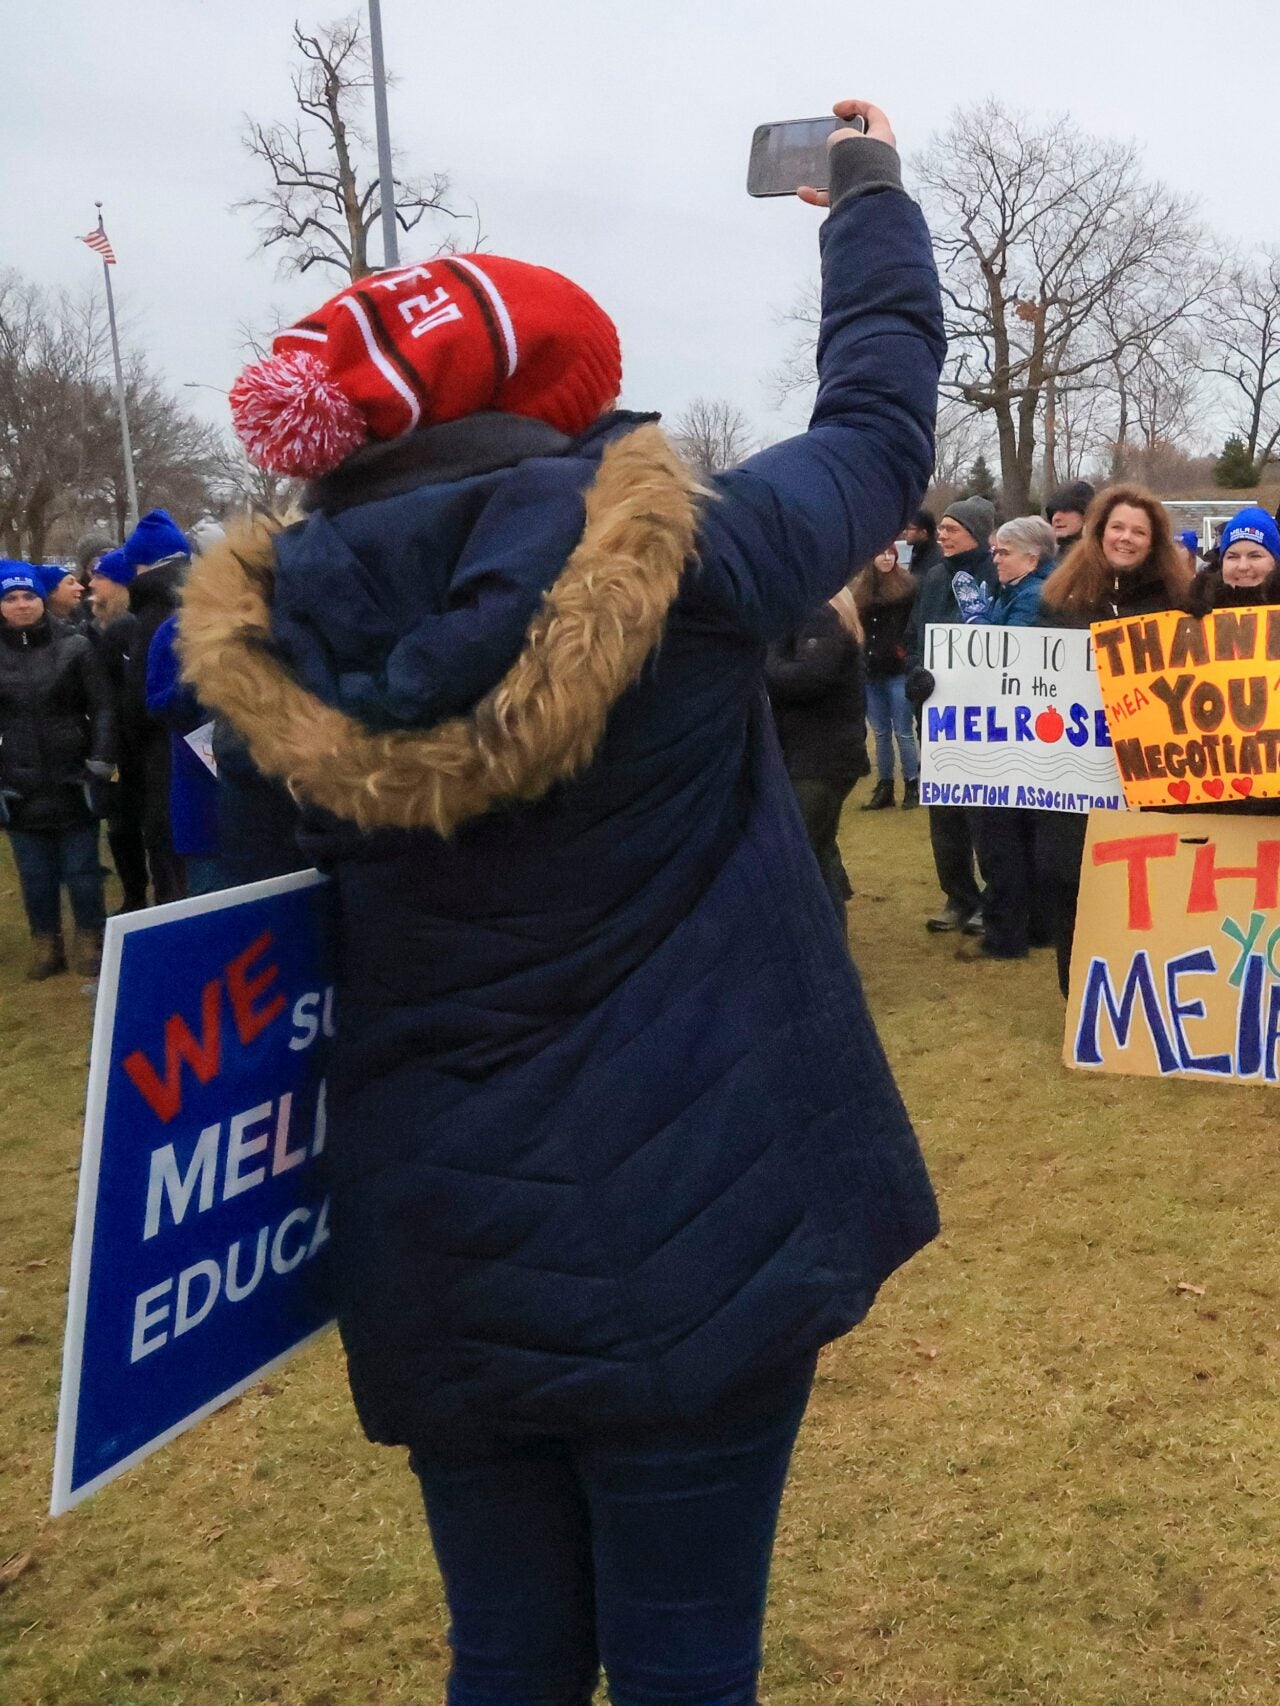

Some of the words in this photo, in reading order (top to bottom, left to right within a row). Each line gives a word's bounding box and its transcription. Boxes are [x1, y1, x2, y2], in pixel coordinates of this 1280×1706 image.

[929, 627, 1021, 671] PROUD
[1041, 635, 1066, 673] TO
[1001, 672, 1021, 697] in
[1031, 675, 1057, 698] the
[1111, 687, 1150, 722] MEA
[1149, 674, 1268, 735] YOU
[921, 782, 1009, 806] EDUCATION
[121, 931, 288, 1125] WE
